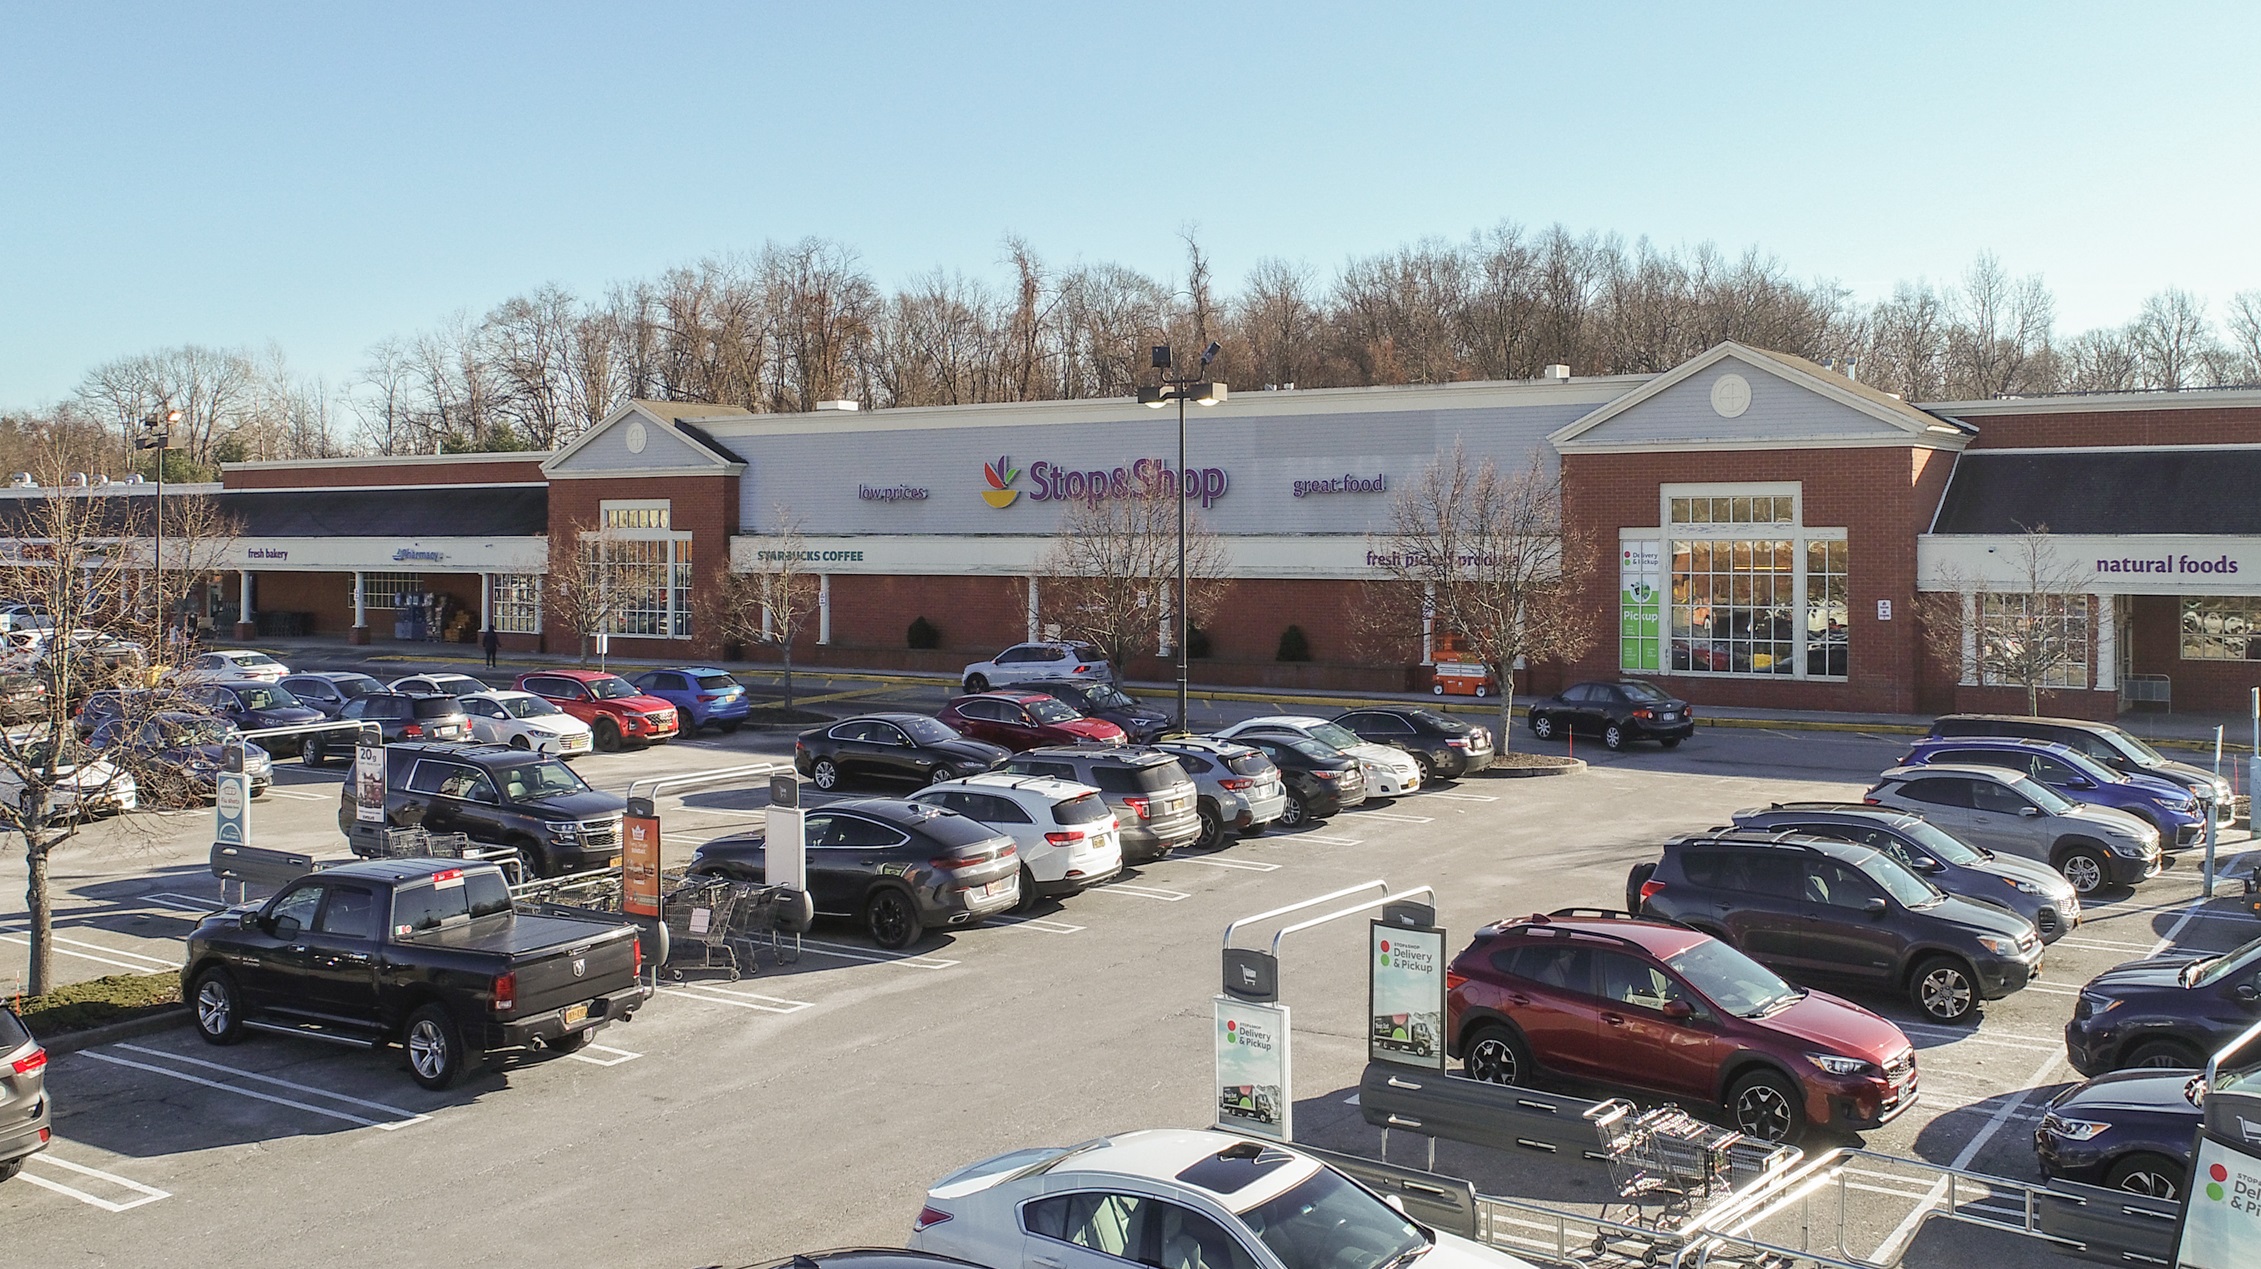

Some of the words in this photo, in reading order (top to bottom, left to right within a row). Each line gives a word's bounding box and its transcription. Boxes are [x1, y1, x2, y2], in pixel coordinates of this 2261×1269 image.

[858, 484, 881, 499] low
[884, 484, 924, 502] prices
[1293, 478, 1337, 497] great
[1343, 473, 1383, 492] food
[248, 548, 264, 558] fresh
[265, 548, 288, 561] bakery
[757, 550, 820, 561] STARBUCKS
[822, 550, 864, 561] COFFEE
[1366, 551, 1401, 566] fresh
[1405, 551, 1454, 568] picd
[1457, 551, 1519, 568] prode
[1632, 552, 1658, 560] Deivery
[2096, 555, 2173, 573] natural
[2179, 555, 2238, 573] foods
[1394, 947, 1432, 963] Delivery
[1393, 958, 1400, 968] &
[1401, 959, 1433, 974] Pickup
[1239, 1027, 1271, 1042] Delivery
[1246, 1039, 1272, 1052] Pickup
[2230, 1195, 2242, 1211] &
